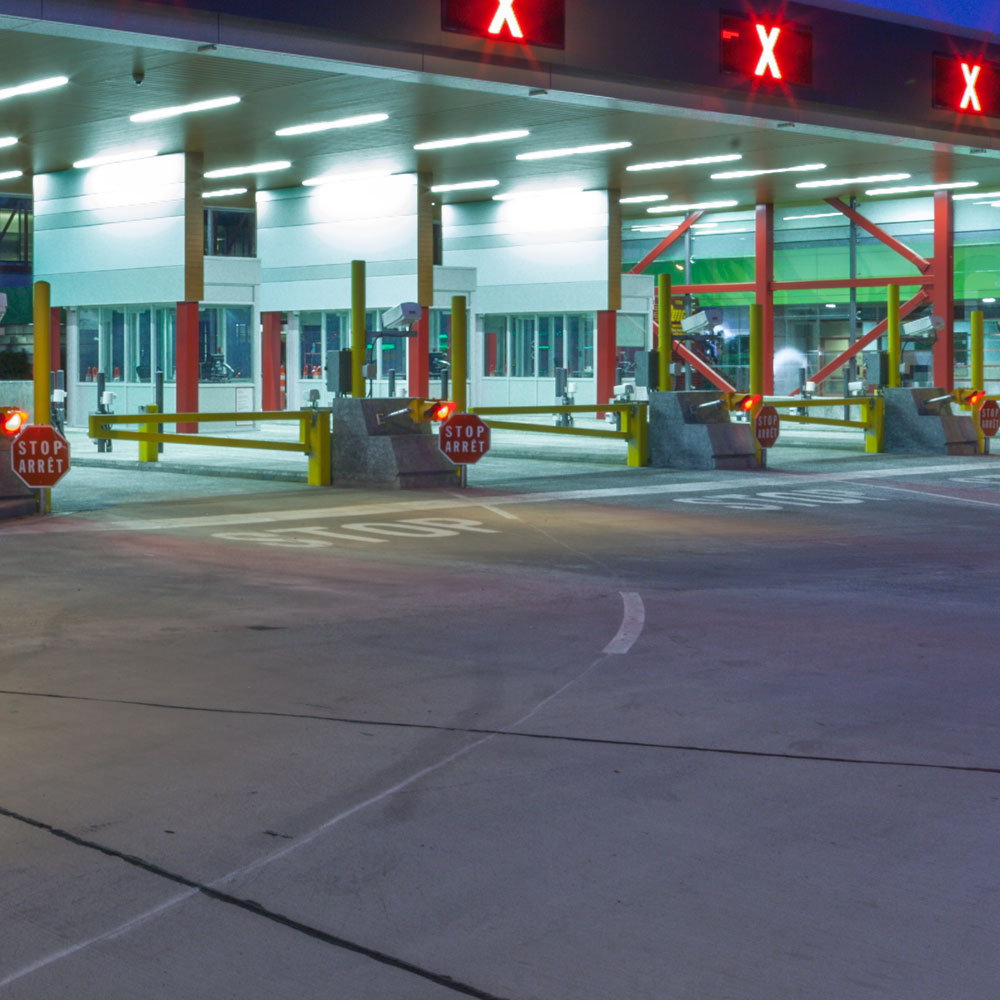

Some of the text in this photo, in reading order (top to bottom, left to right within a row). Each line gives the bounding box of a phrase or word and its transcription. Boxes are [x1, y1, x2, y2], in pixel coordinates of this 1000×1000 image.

[754, 24, 782, 79] X
[961, 62, 981, 111] X
[982, 407, 999, 417] STOP
[758, 415, 778, 426] STOP
[445, 425, 484, 438] STOP
[18, 440, 62, 455] STOP
[445, 439, 485, 453] ARRÊT
[19, 457, 63, 473] ARRÊT
[211, 517, 502, 549] STOP
